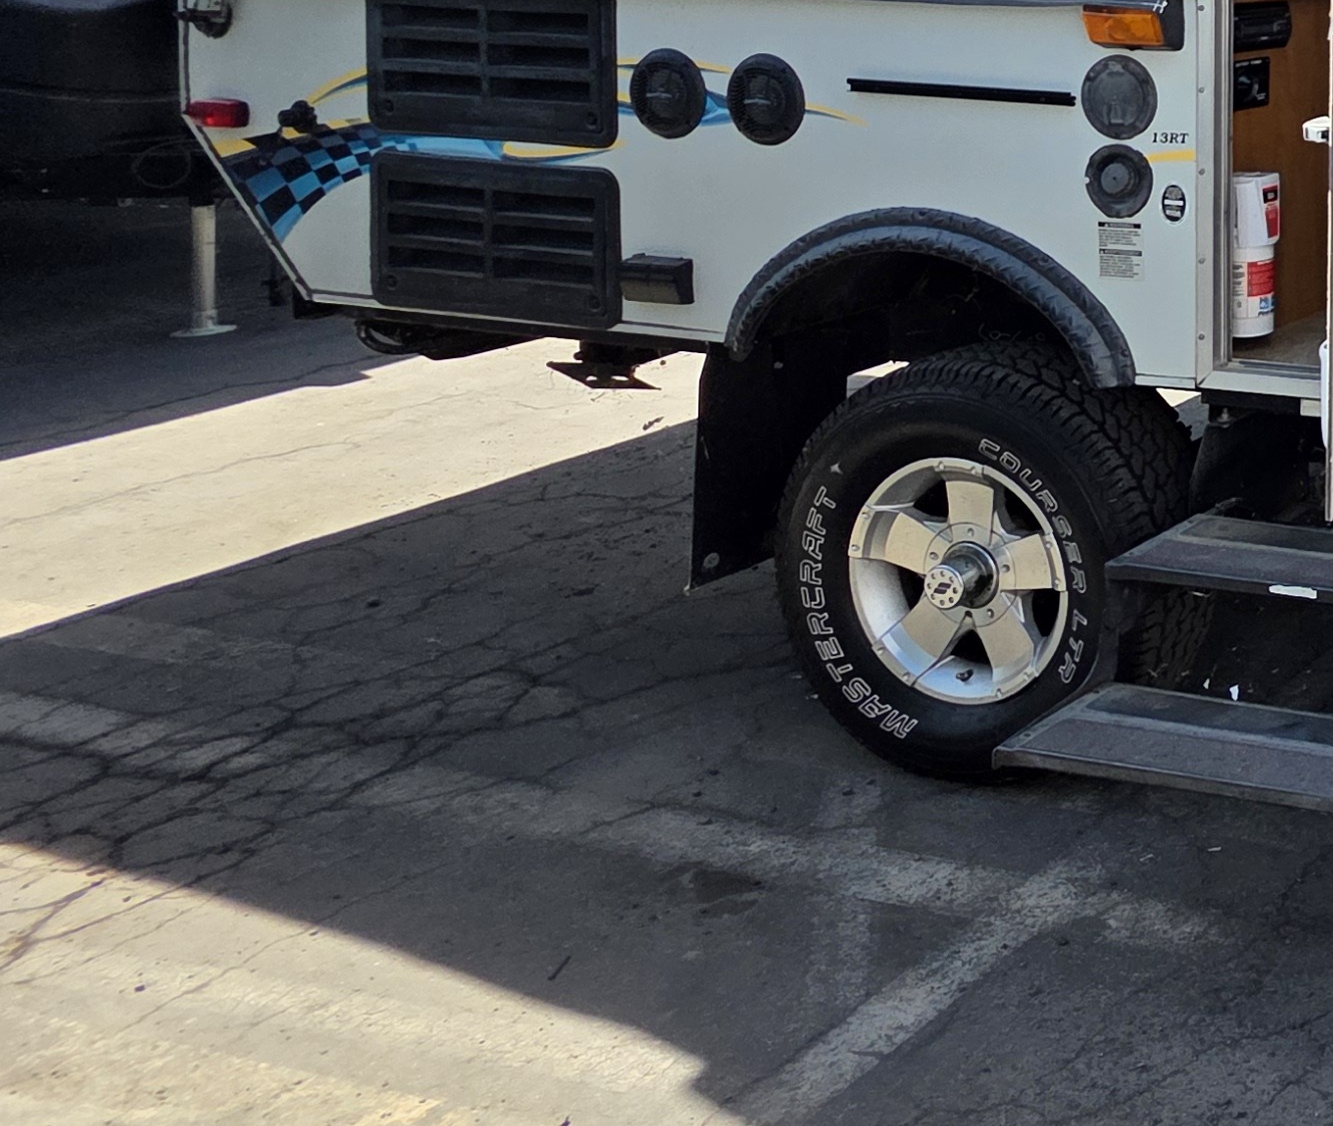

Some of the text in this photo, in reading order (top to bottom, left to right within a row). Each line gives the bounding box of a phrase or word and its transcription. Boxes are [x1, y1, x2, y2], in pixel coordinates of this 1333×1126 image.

[1152, 131, 1190, 144] 13RT
[798, 485, 919, 740] MASTERCRAFT
[978, 437, 1088, 685] COURSER LTR
